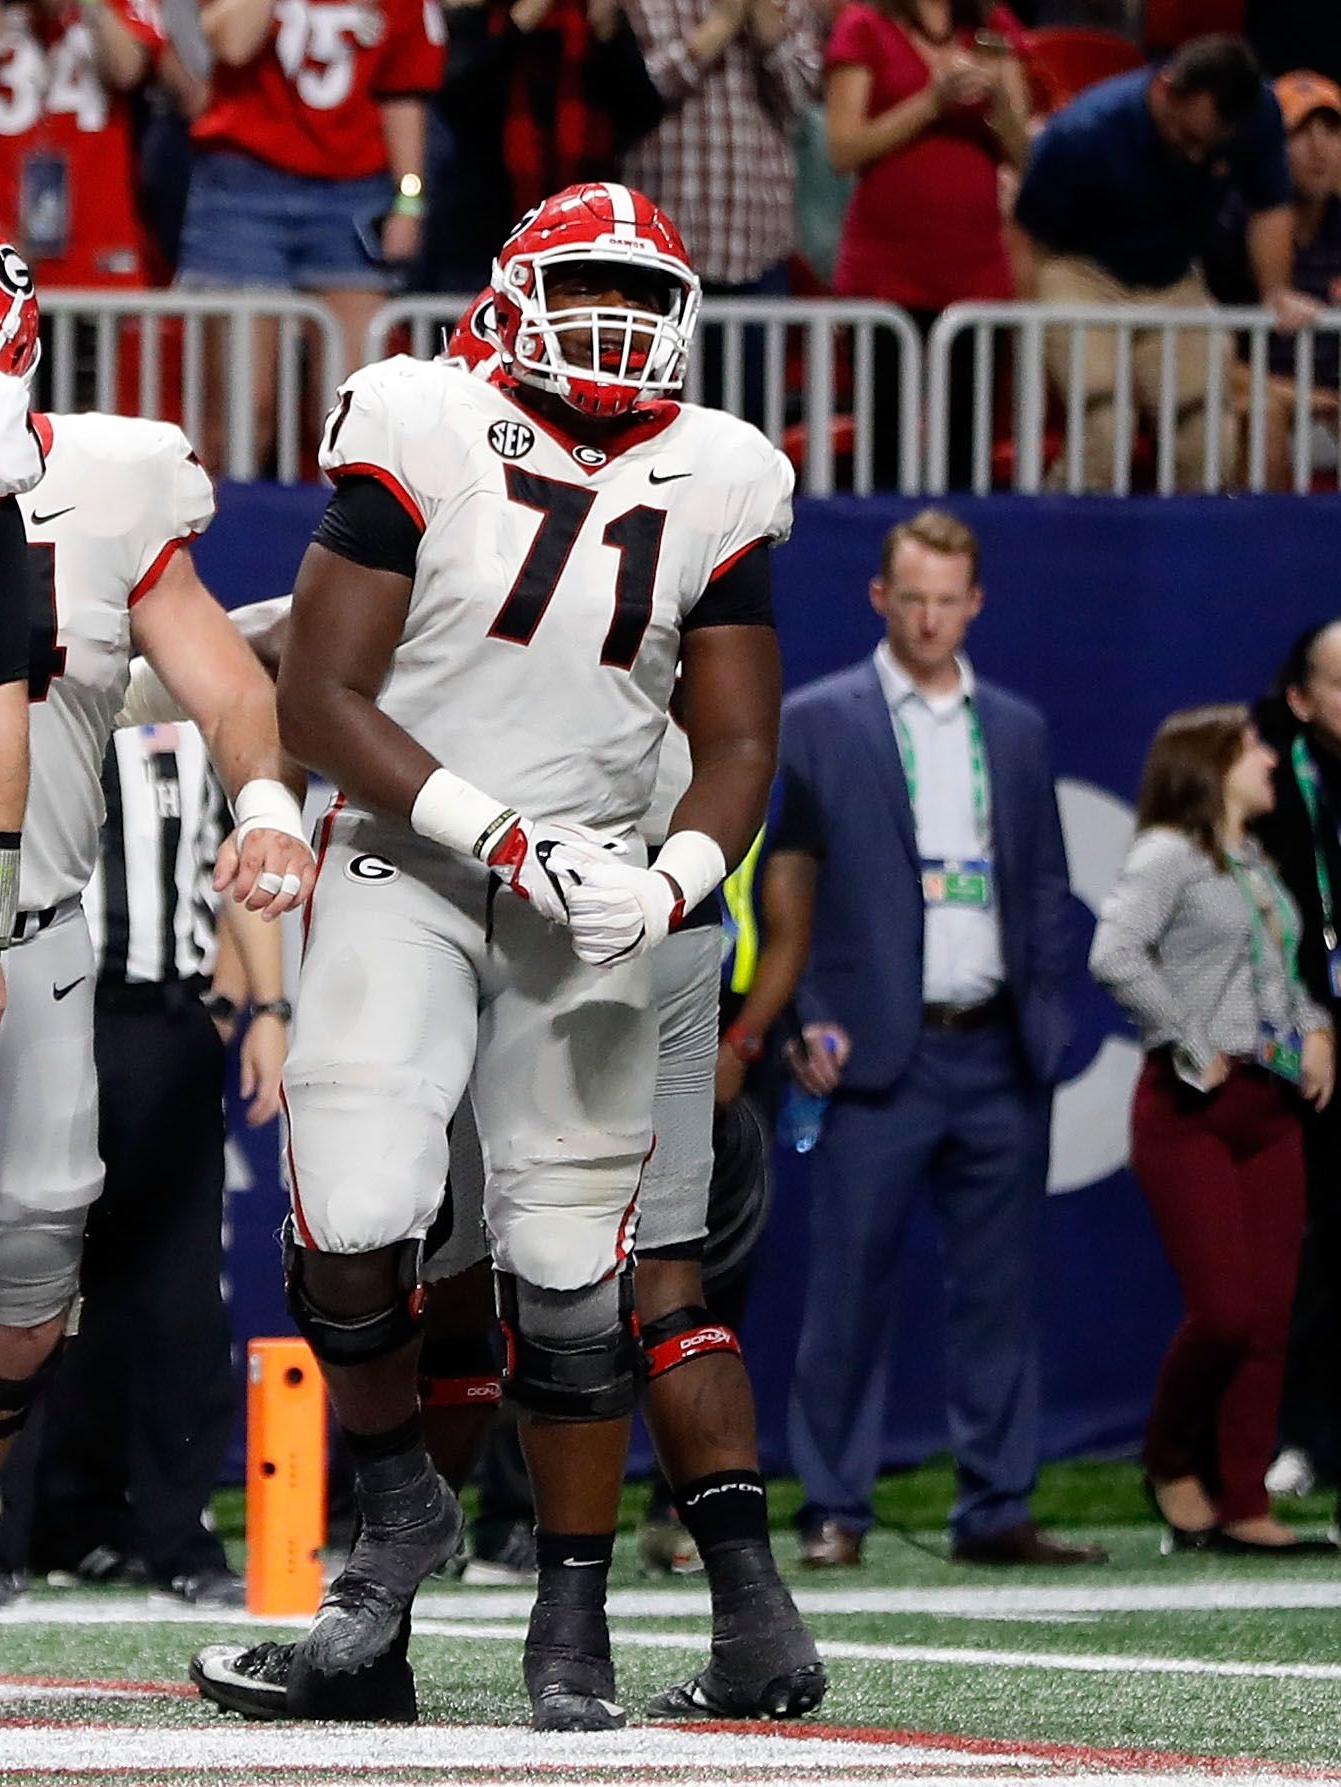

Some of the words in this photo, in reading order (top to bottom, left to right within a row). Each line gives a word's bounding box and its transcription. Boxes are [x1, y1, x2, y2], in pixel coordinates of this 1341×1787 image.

[489, 421, 533, 458] SEC
[485, 462, 668, 672] 71
[347, 853, 399, 880] G
